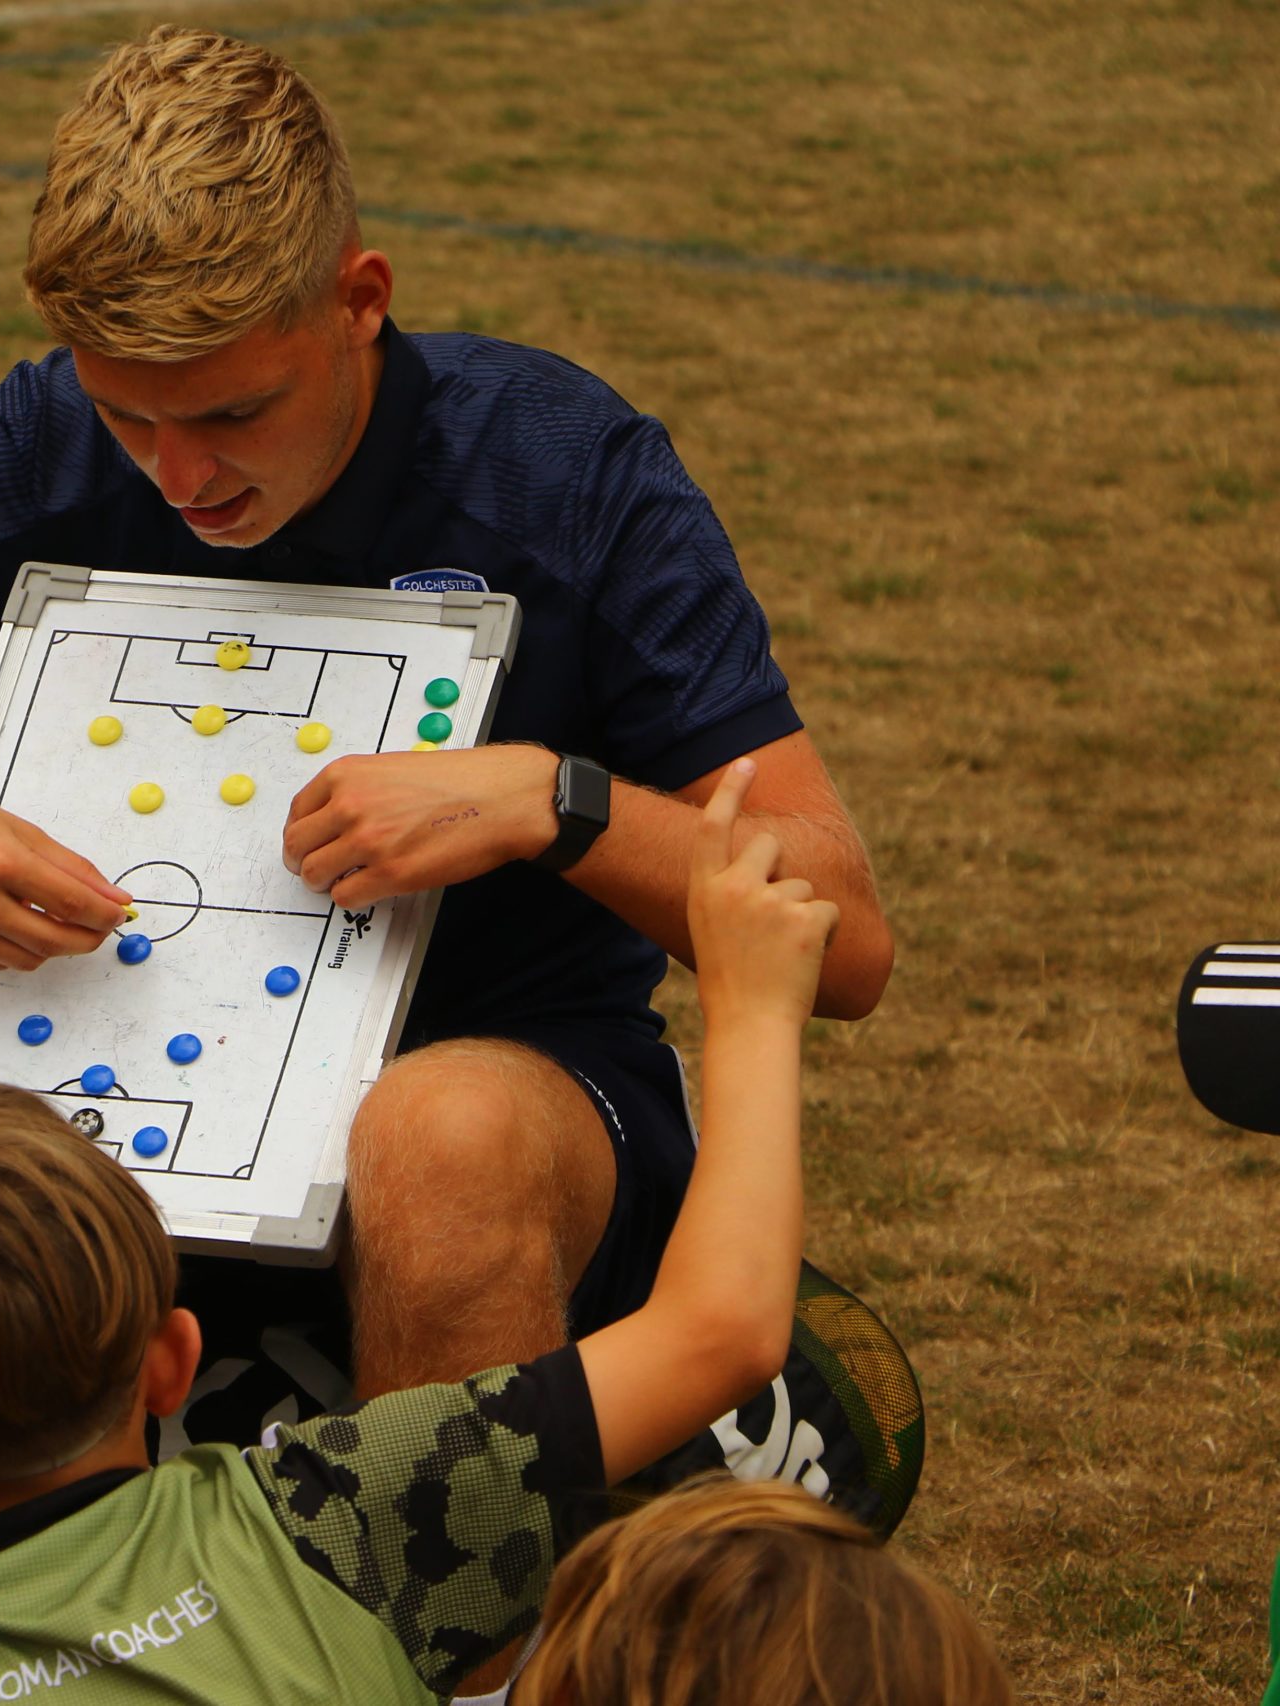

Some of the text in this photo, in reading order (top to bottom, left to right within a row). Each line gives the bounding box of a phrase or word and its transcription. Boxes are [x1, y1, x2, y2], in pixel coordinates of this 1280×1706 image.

[402, 580, 476, 591] COLCHESTER
[327, 927, 356, 969] training
[90, 1580, 218, 1664] COACHES
